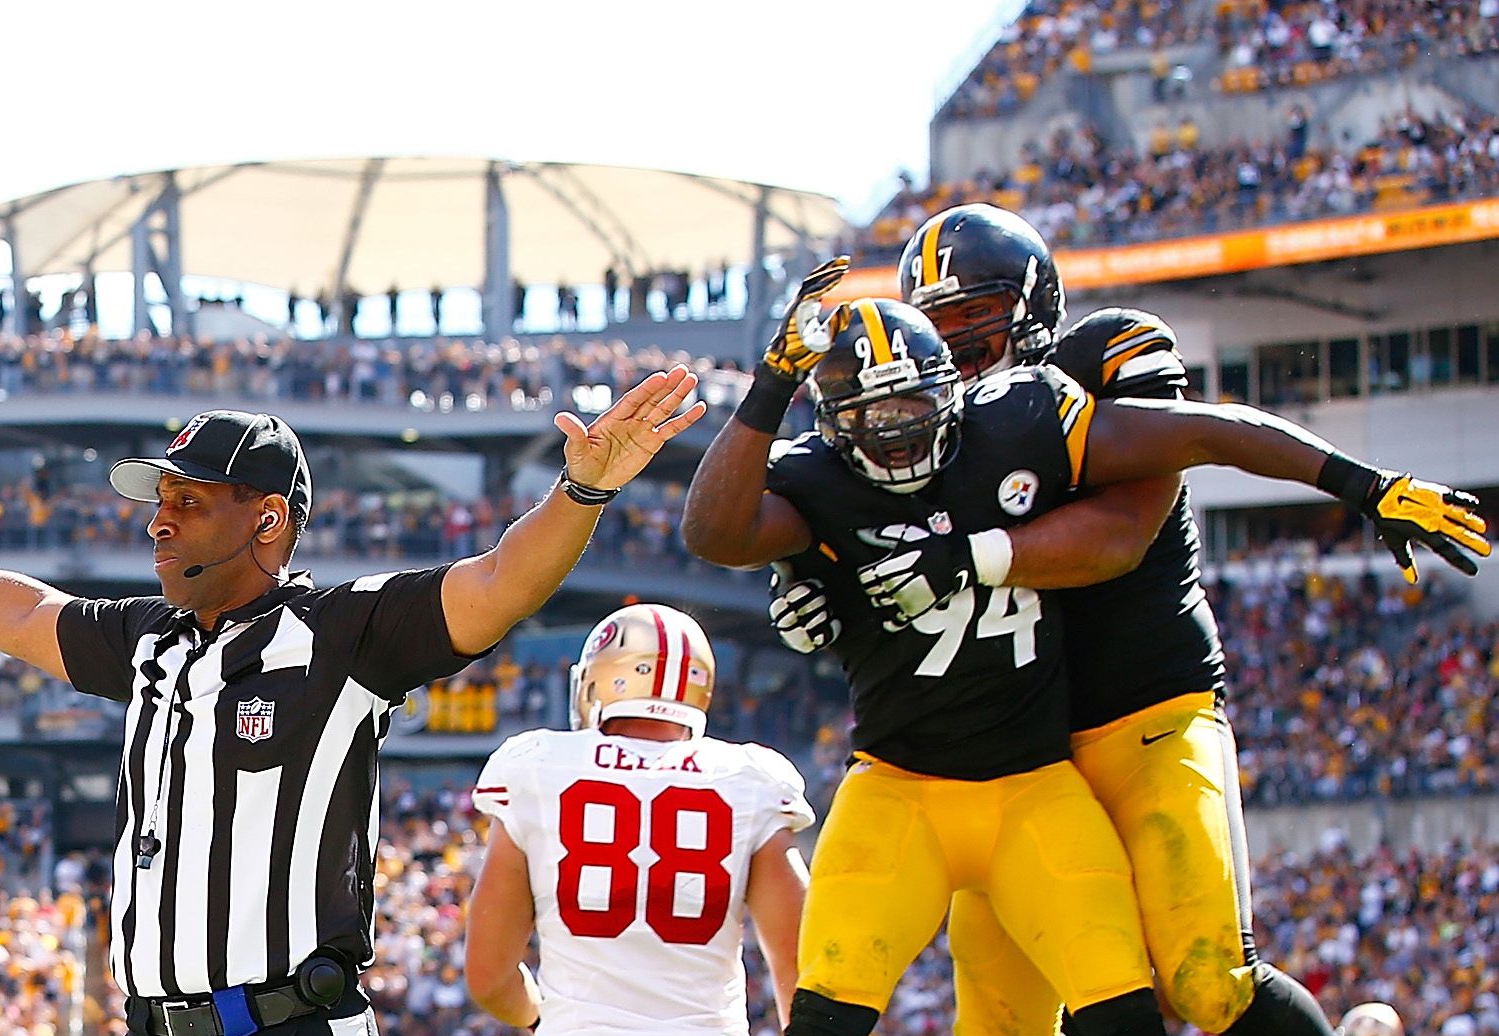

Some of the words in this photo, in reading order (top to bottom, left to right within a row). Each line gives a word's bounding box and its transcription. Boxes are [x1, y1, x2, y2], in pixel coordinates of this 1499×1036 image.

[911, 246, 953, 288] 97
[855, 329, 908, 370] 94
[912, 585, 1043, 678] 94
[239, 716, 269, 737] NFL
[594, 743, 703, 773] CELK
[556, 779, 733, 945] 88
